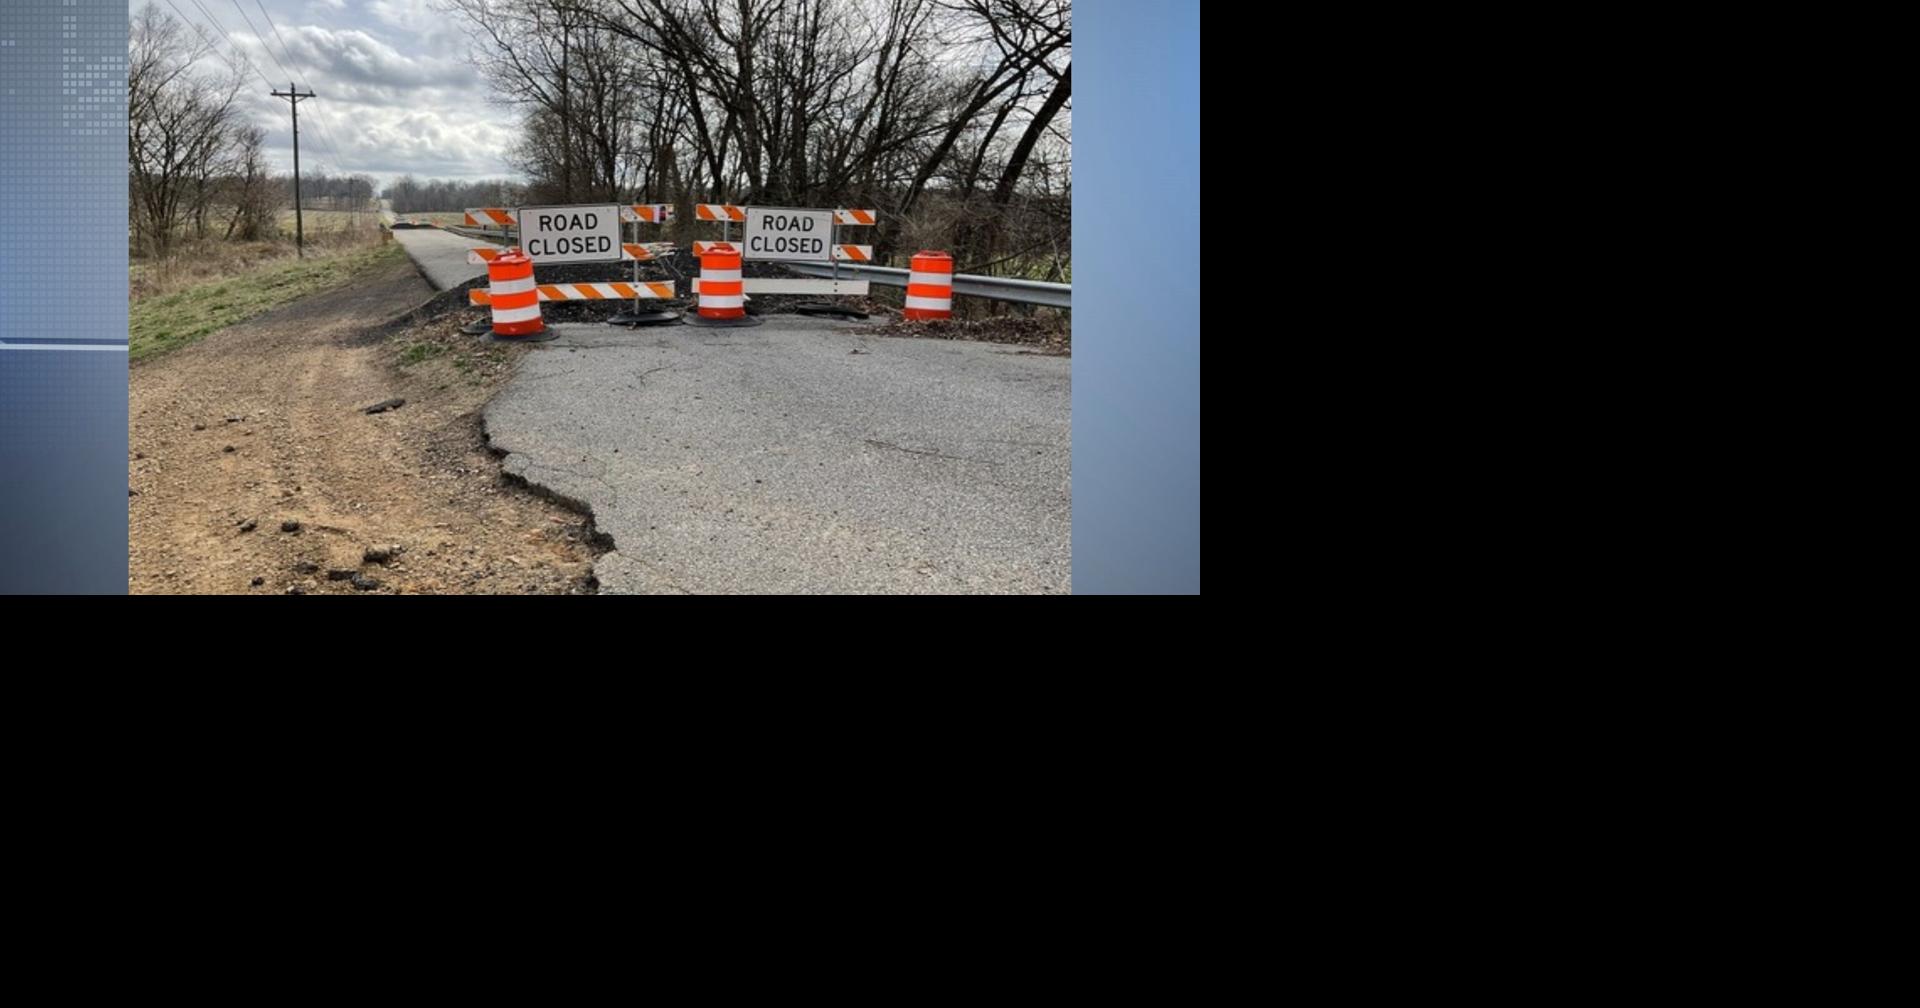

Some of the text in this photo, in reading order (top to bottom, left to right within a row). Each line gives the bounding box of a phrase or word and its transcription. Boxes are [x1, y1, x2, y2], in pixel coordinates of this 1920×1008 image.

[539, 213, 598, 232] ROAD
[762, 215, 814, 232] ROAD
[528, 236, 611, 256] CLOSED
[750, 236, 823, 254] CLOSED
